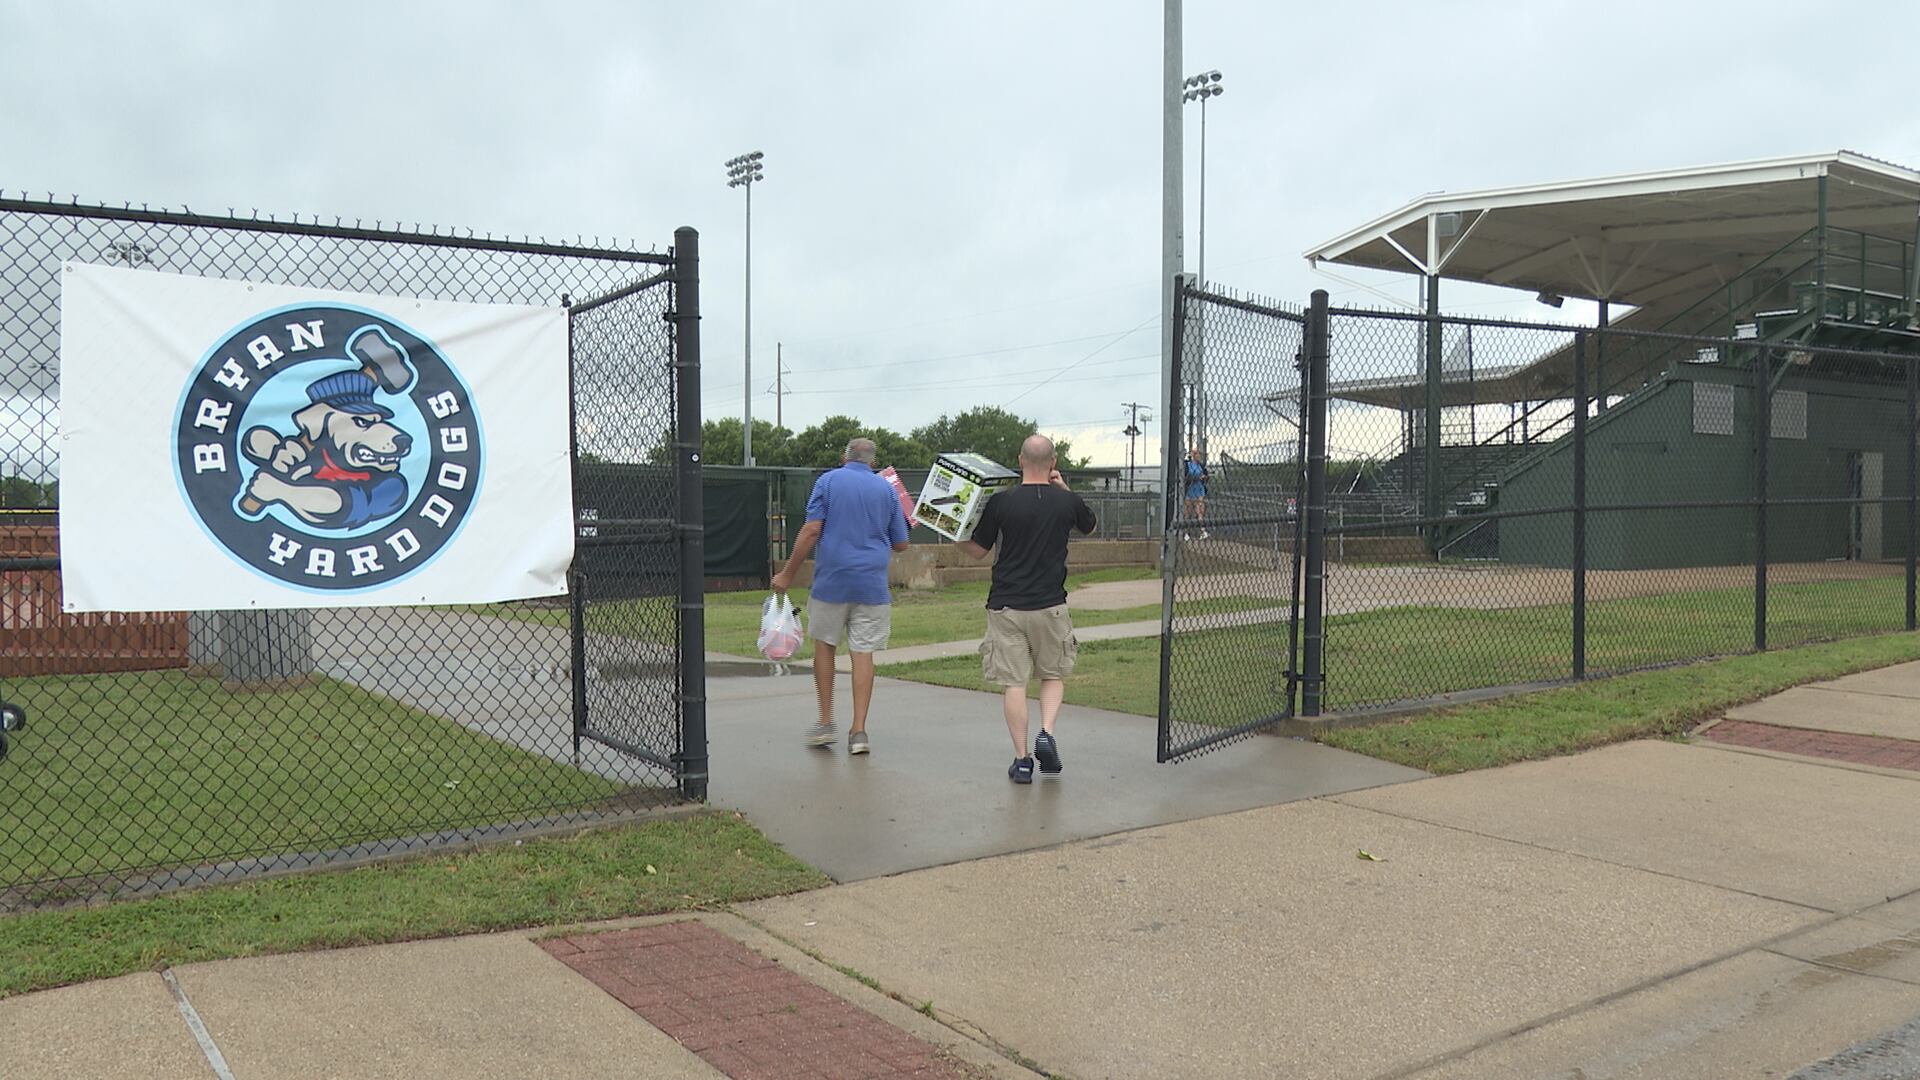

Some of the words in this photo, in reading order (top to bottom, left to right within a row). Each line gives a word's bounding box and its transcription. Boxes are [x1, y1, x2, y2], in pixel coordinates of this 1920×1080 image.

[193, 319, 325, 475] BRYAN
[268, 527, 421, 578] YARD
[418, 390, 469, 529] DOGS
